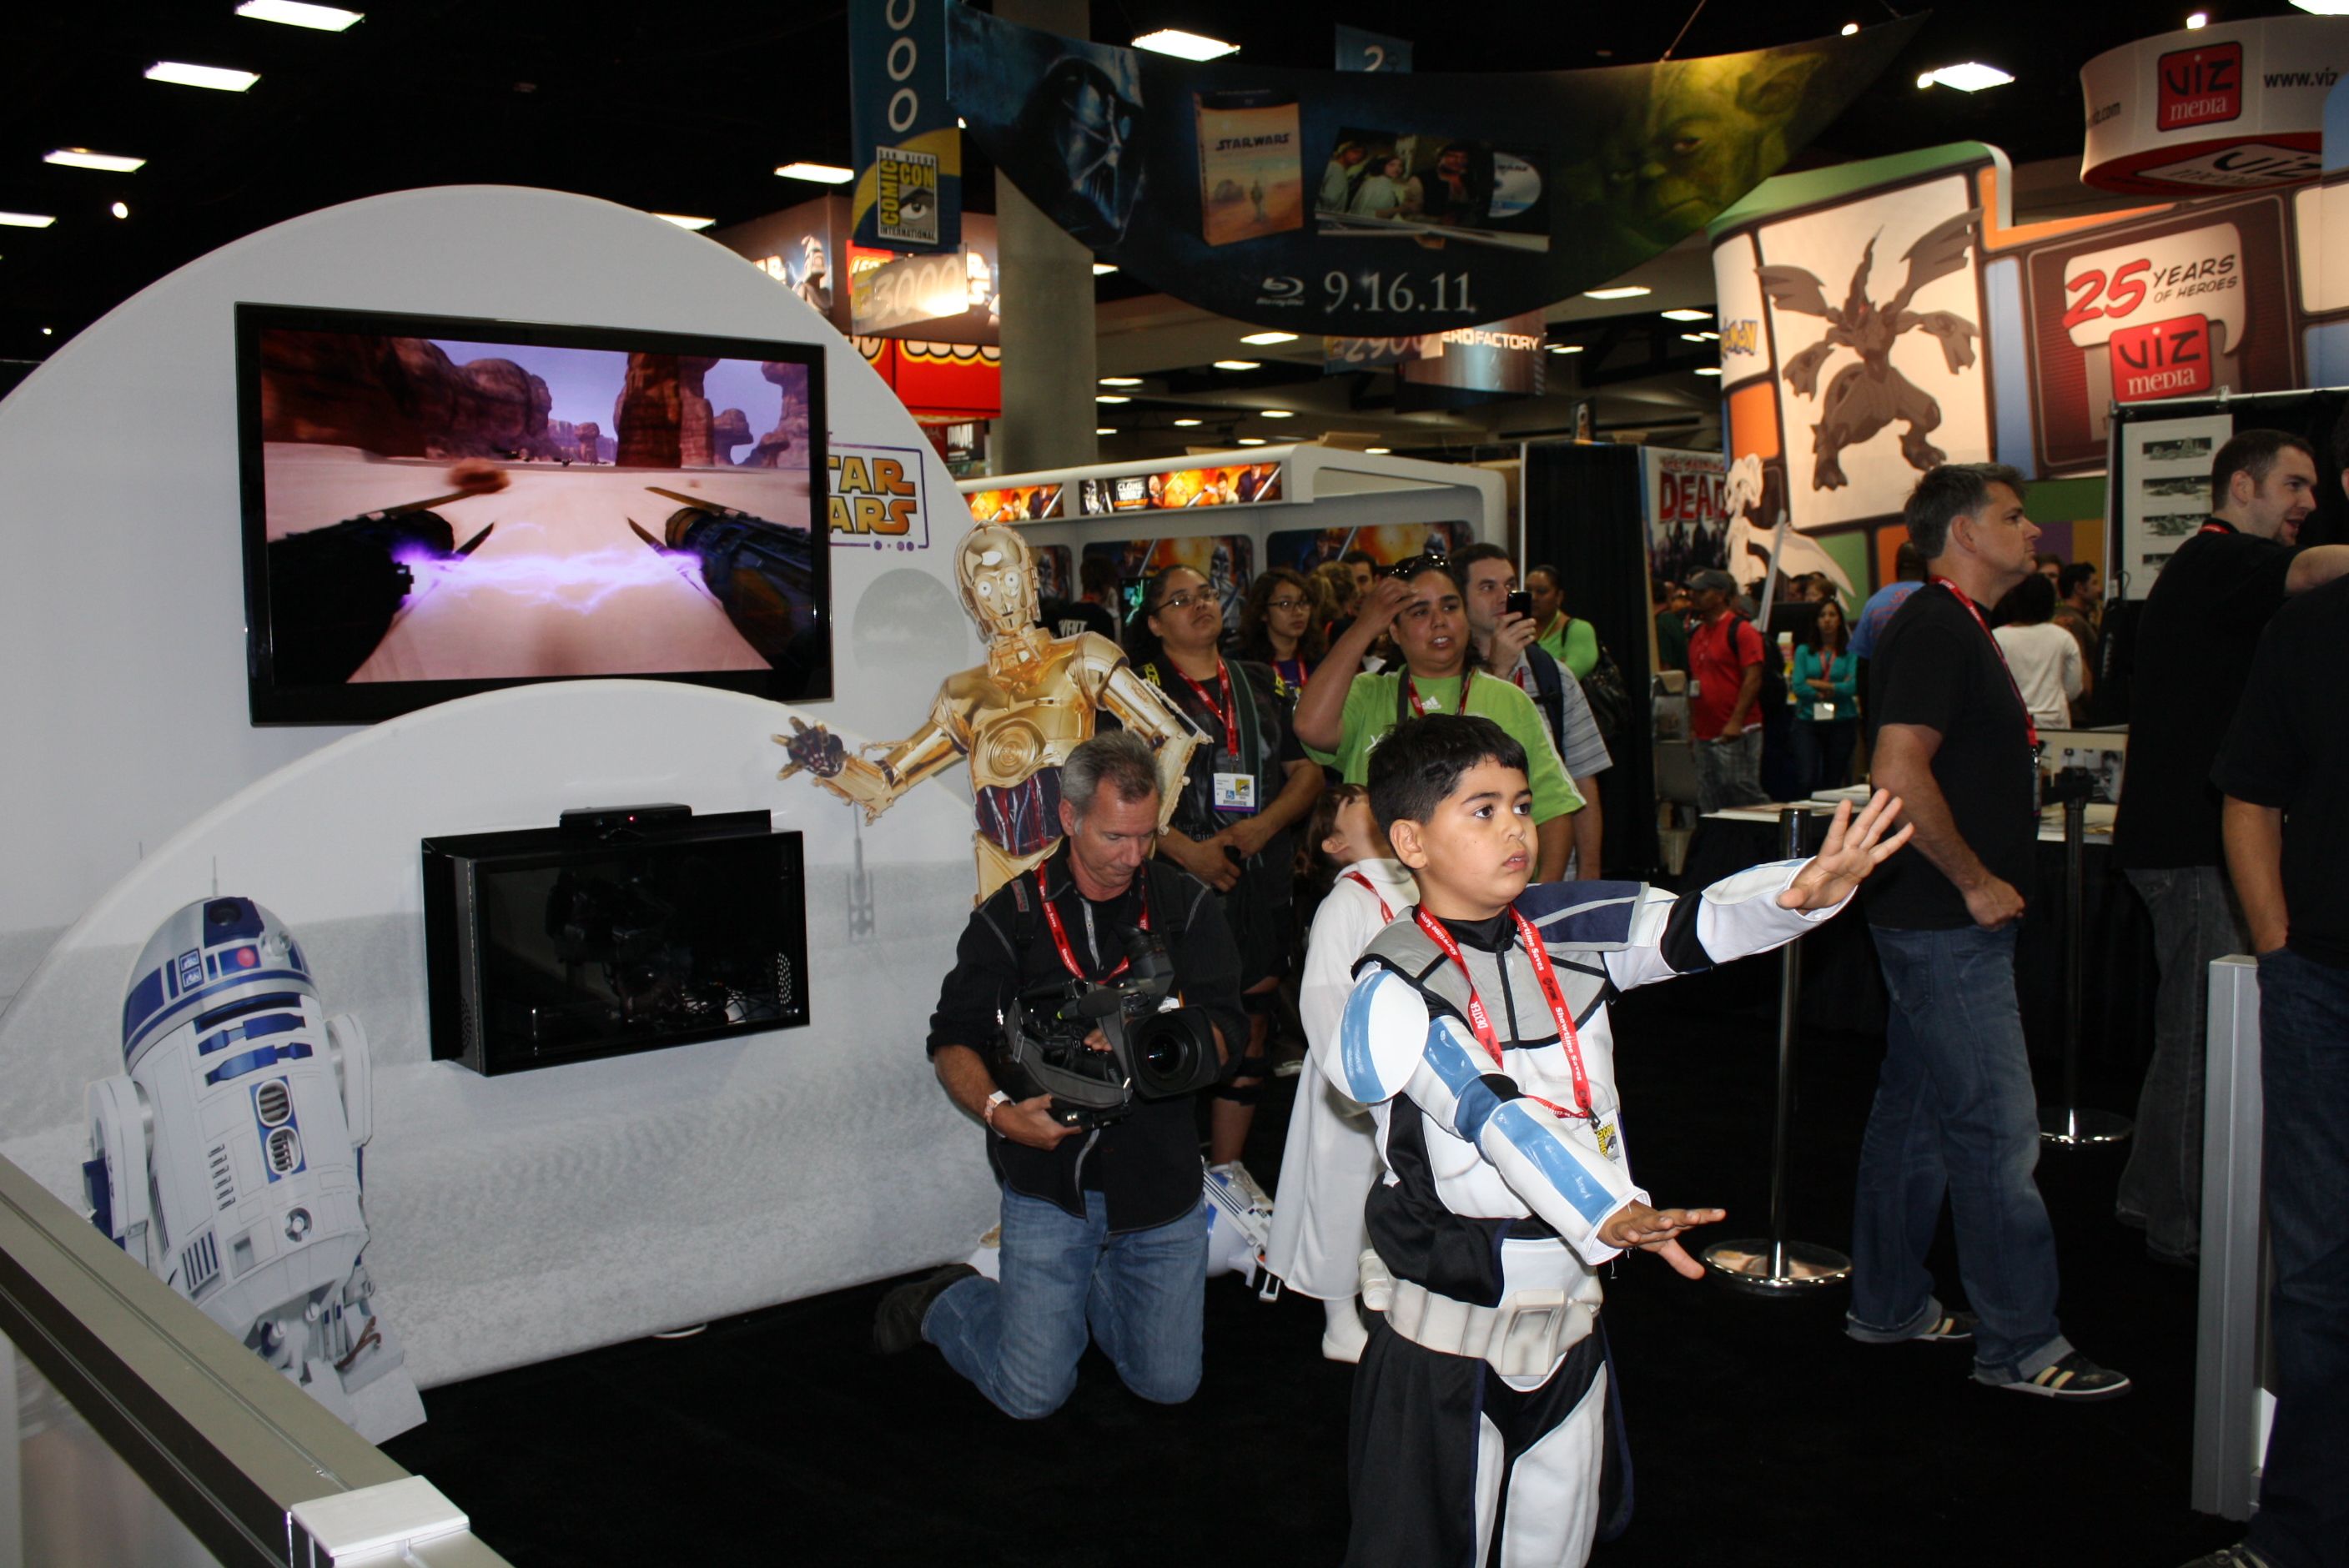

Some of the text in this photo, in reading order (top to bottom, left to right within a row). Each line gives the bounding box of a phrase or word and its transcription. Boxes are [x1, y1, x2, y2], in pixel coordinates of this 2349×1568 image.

[880, 160, 899, 225] COMIC
[899, 162, 934, 188] CON
[880, 226, 935, 242] INTERNATIONAL
[875, 255, 959, 323] 3000
[1324, 270, 1478, 314] 9.16.11
[2062, 254, 2236, 329] 25 YEARS
[2154, 275, 2238, 303] OF HEROES
[827, 495, 917, 535] ARS
[1531, 947, 1544, 972] Saves
[1469, 1000, 1489, 1030] DEXTER
[1554, 1006, 1582, 1082] Showtime Saves
